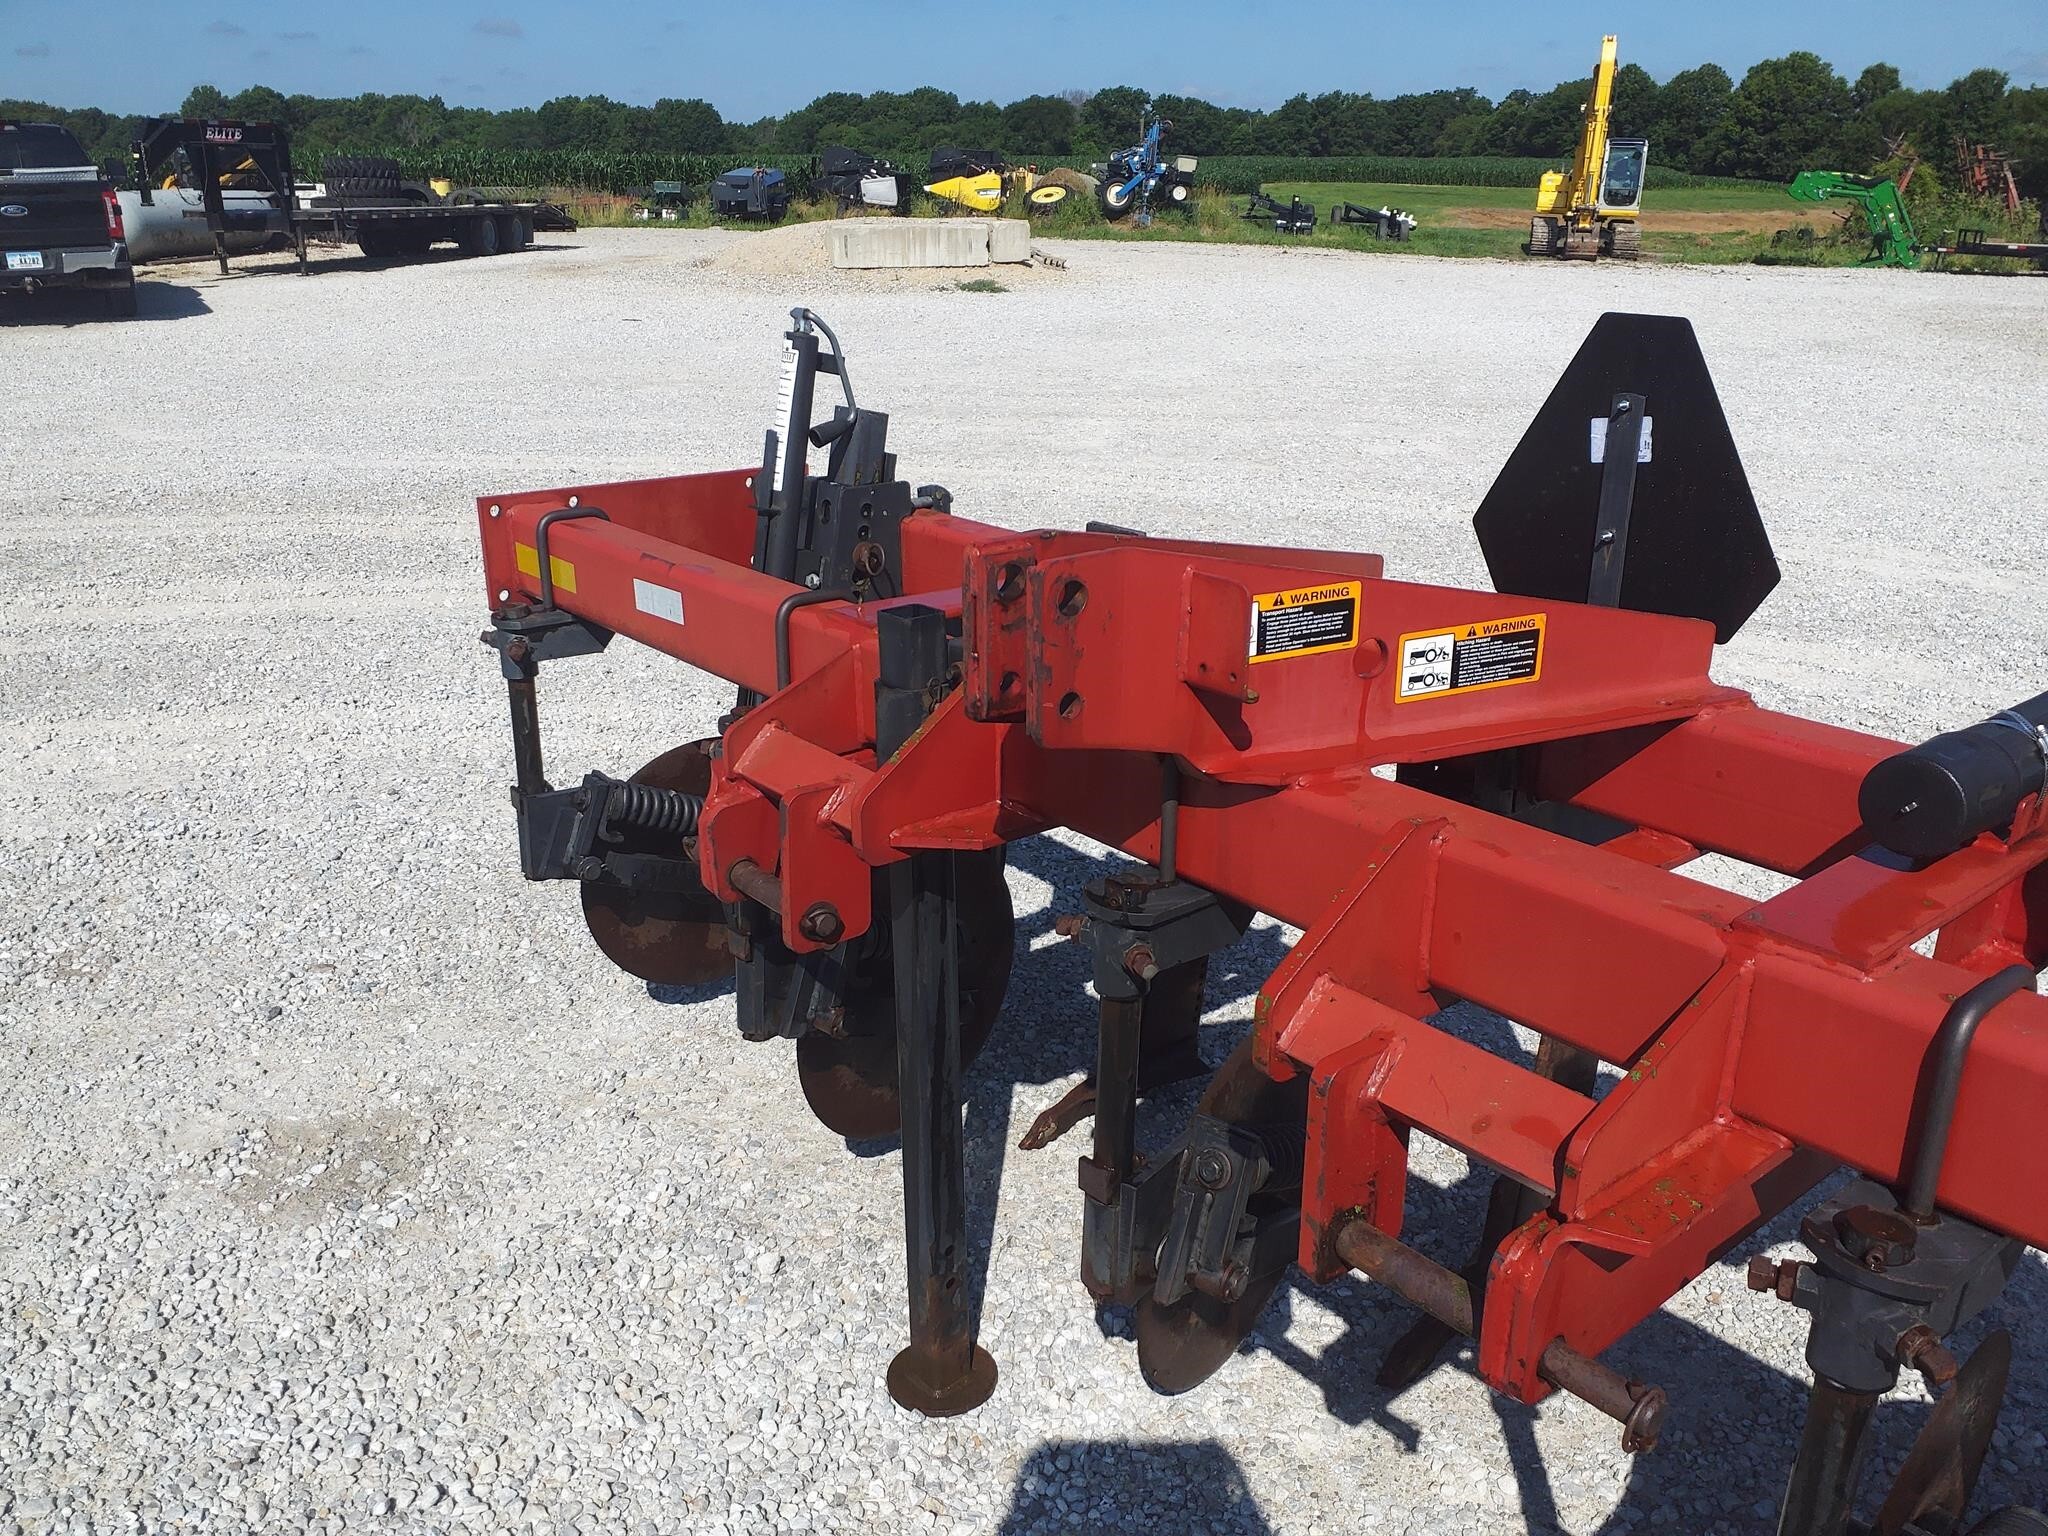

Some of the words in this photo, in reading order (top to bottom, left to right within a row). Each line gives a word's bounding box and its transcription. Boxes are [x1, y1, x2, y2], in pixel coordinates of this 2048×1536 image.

[206, 127, 243, 139] ELITE
[1290, 587, 1350, 604] WARNING
[1483, 619, 1536, 635] WARNING
